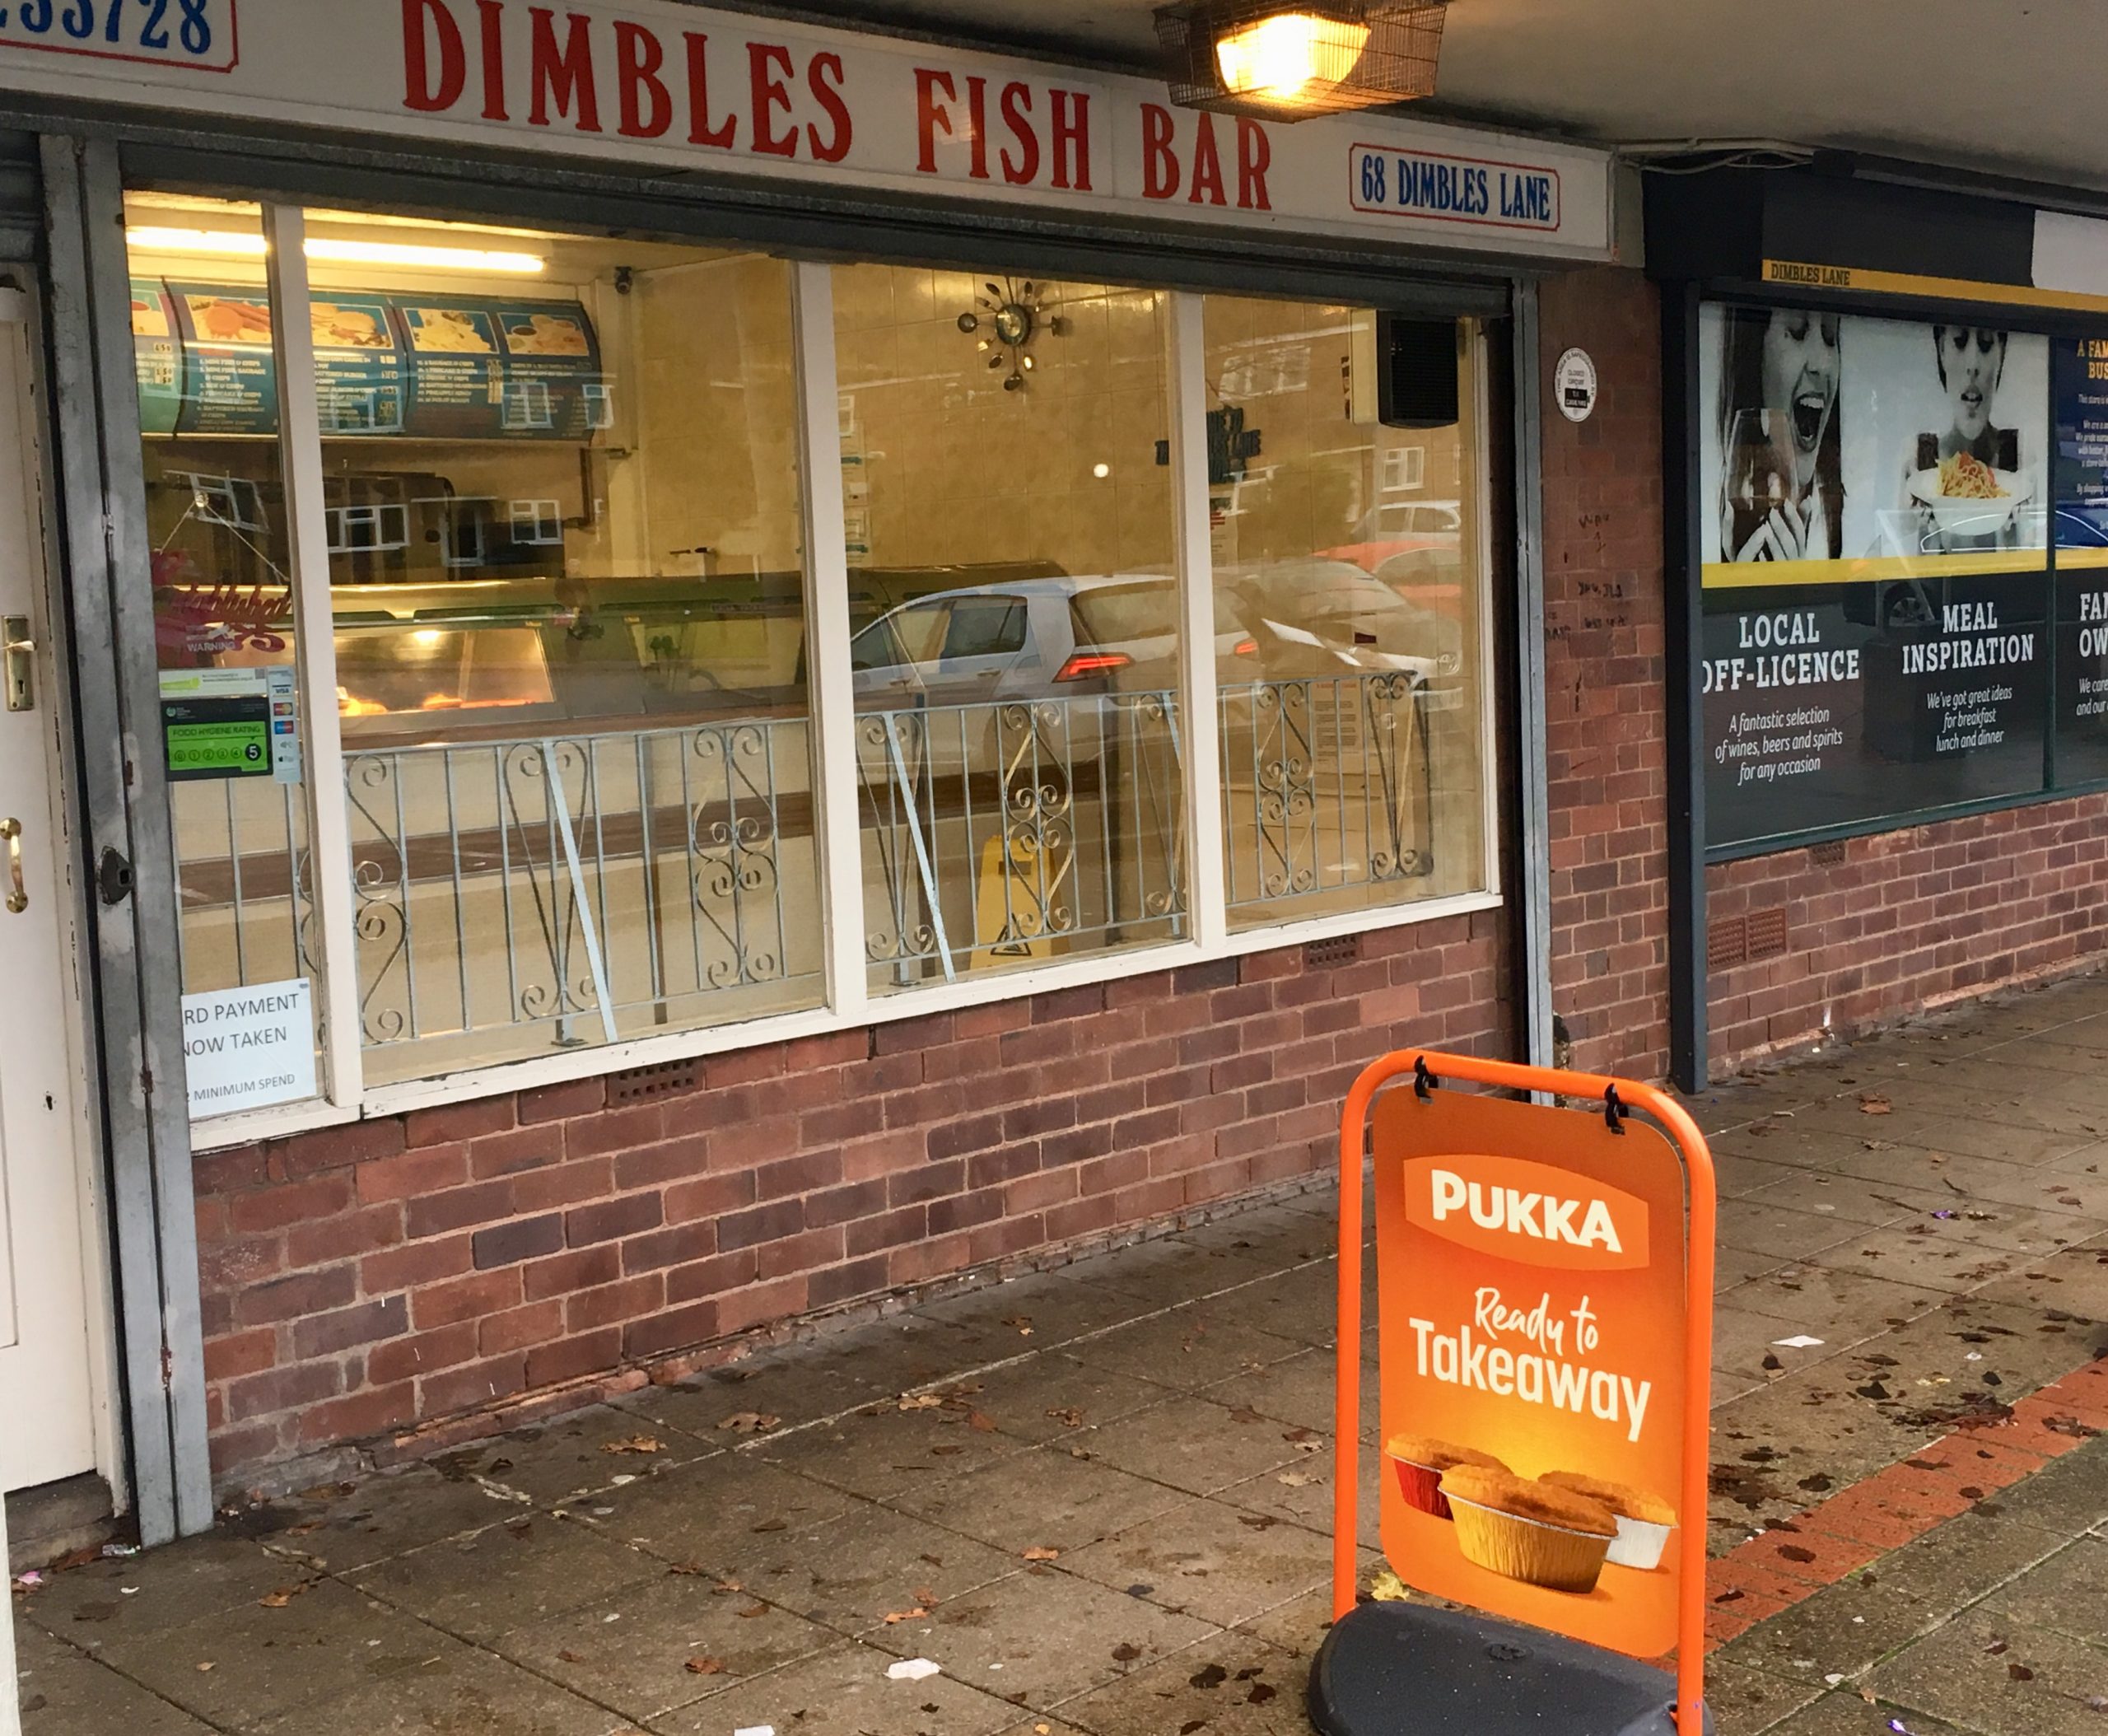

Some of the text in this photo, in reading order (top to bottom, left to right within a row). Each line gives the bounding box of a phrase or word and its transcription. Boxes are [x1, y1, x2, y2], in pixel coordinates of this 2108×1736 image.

[402, 0, 1271, 211] DIMBLES FISH BAR
[1361, 154, 1551, 222] 68 DIMBLES LANE
[1771, 263, 1850, 286] DIMBLES LANE
[1739, 613, 1820, 648] LOCAL
[1942, 602, 1998, 633] MEAL
[186, 641, 236, 653] WARNING
[1902, 633, 2035, 674] INSPIRATION
[1702, 649, 1859, 693] OFF-LICENCE
[2079, 678, 2091, 693] We
[1927, 684, 2012, 711] We've got great ideas
[2077, 698, 2092, 716] and
[198, 726, 231, 735] HYGIENE
[232, 725, 260, 734] RATING
[1729, 706, 1830, 736] A fantastic selection
[1942, 707, 1997, 734] for breakfast
[249, 746, 258, 758] 5
[1715, 728, 1844, 764] of wines, beers and spirits
[1936, 730, 2005, 752] lunch and dinner
[1737, 754, 1821, 786] for any occasion
[184, 993, 299, 1025] RD PAYMENT
[230, 1026, 287, 1049] TAKEN
[194, 1080, 255, 1100] MINIMUM
[259, 1074, 295, 1090] SPEND
[1431, 1169, 1622, 1253] PUKKA
[1475, 1286, 1599, 1356] Ready to
[1409, 1318, 1652, 1443] Takeaway
